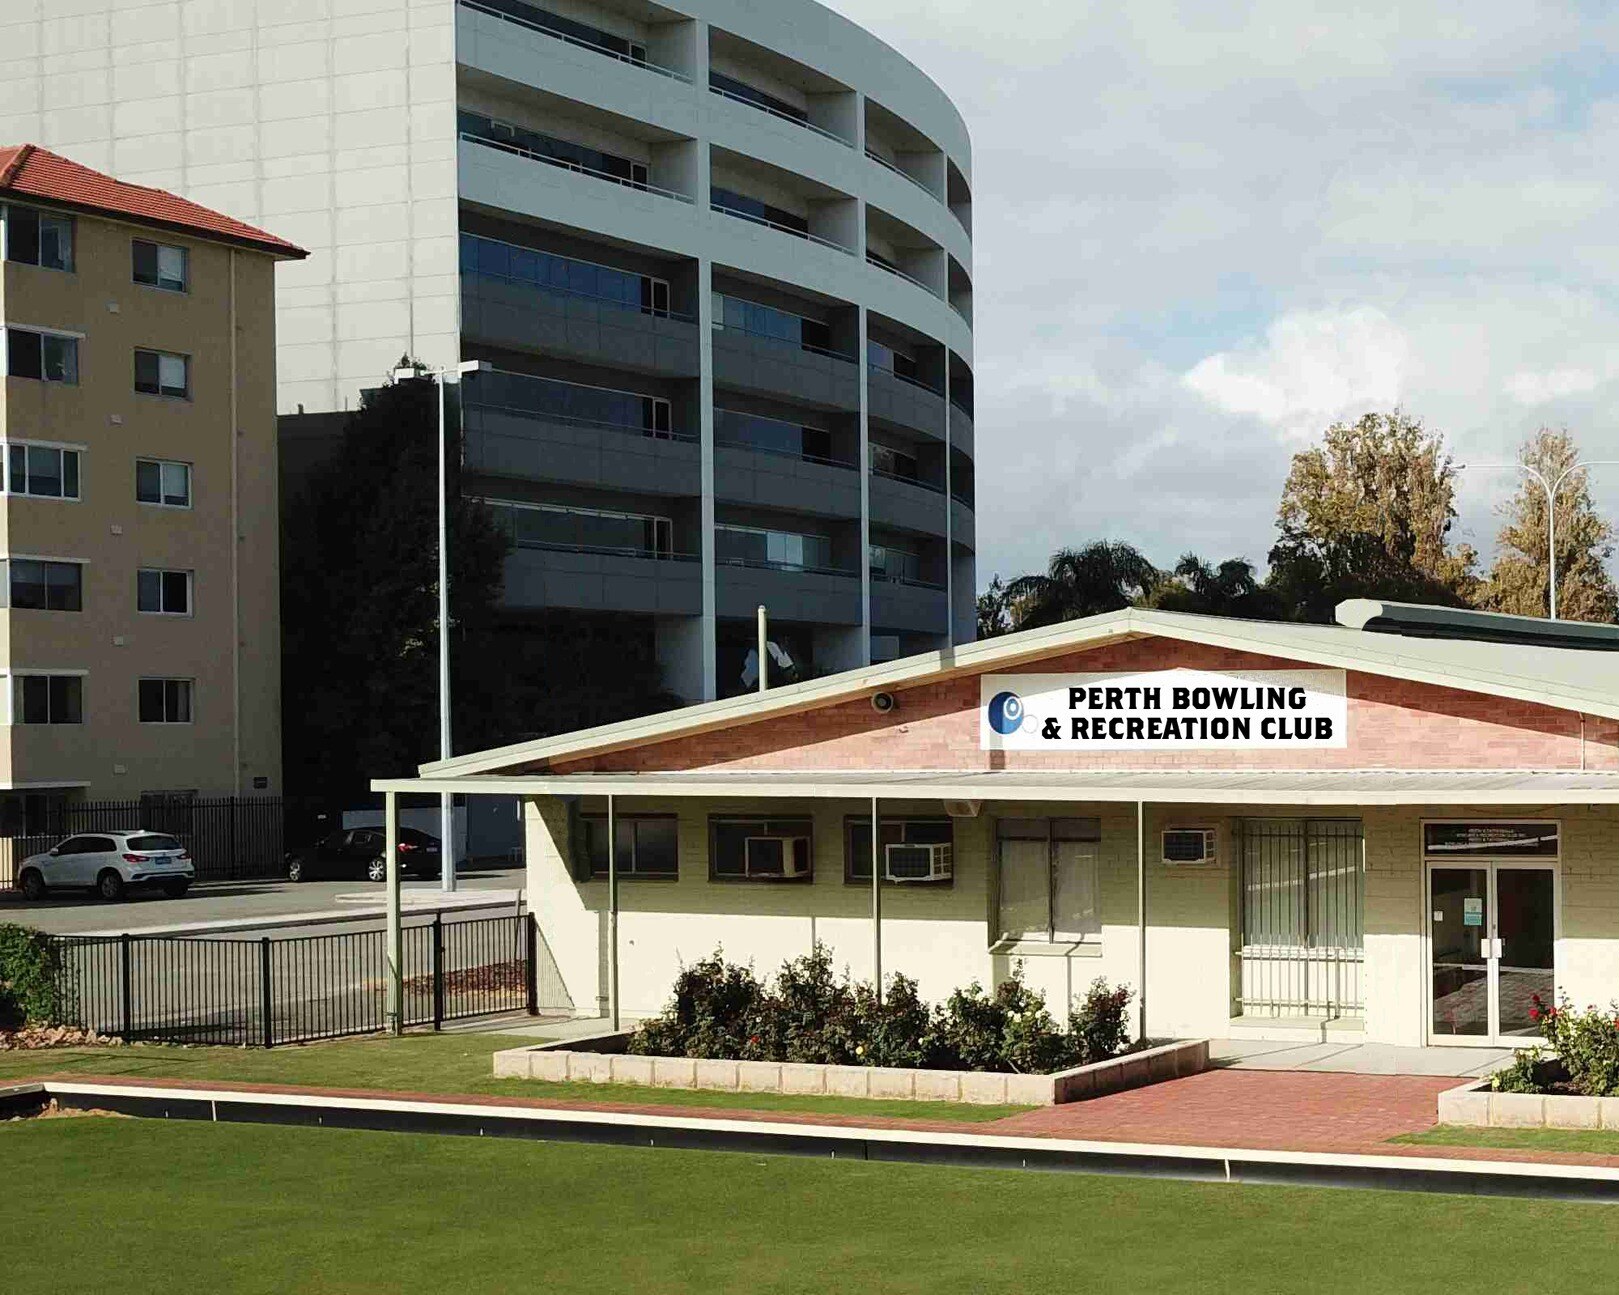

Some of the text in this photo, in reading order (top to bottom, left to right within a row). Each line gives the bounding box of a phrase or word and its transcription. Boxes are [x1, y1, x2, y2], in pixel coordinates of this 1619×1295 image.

[1068, 687, 1307, 710] PERTH BOWLING
[1041, 717, 1333, 740] & RECREATION CLUB
